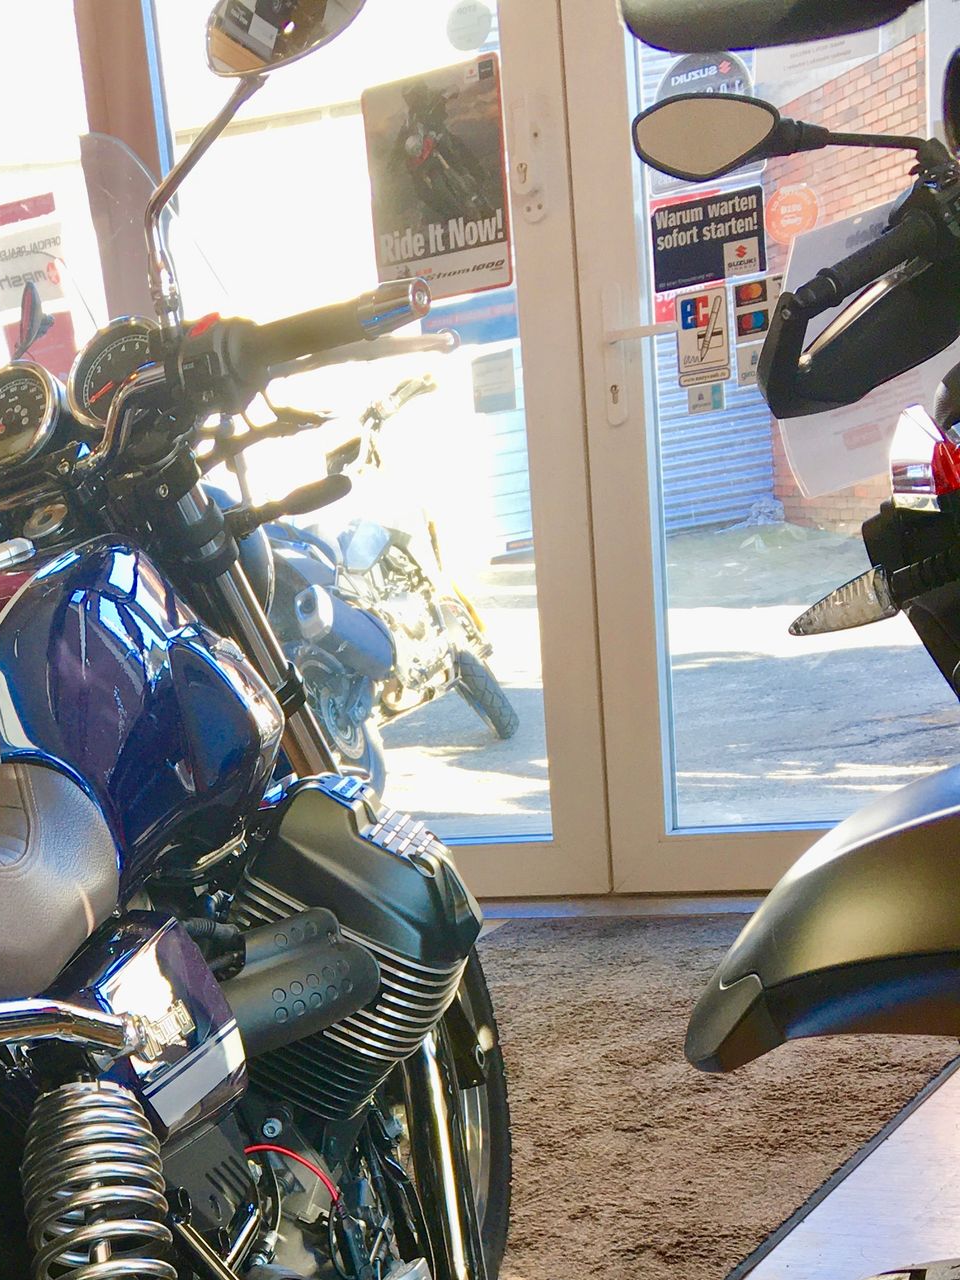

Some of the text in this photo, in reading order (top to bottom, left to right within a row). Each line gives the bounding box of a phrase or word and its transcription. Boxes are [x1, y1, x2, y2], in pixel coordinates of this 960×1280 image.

[655, 206, 703, 230] Warum
[708, 194, 757, 218] warten
[380, 208, 504, 263] Ride It Now!
[656, 227, 698, 251] sofort
[703, 211, 758, 241] starten!
[727, 258, 757, 268] SUZUKI
[107, 353, 112, 361] 3
